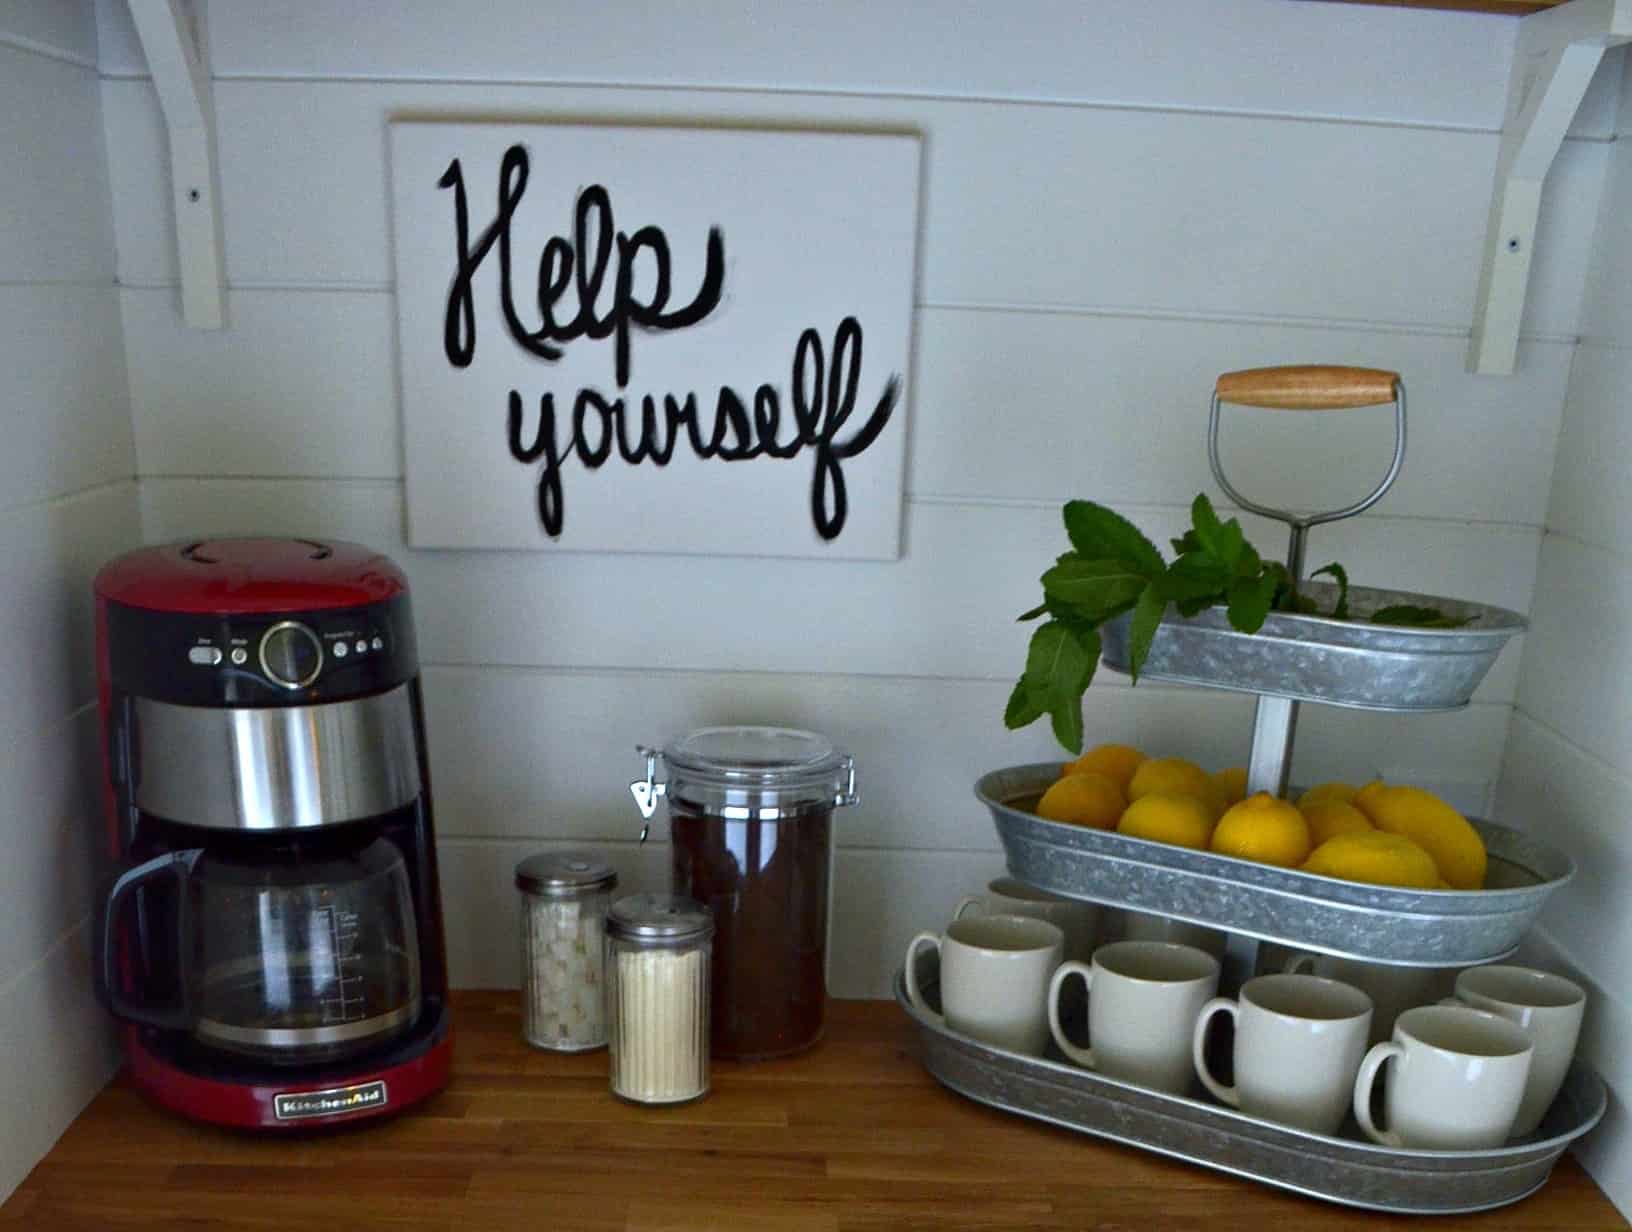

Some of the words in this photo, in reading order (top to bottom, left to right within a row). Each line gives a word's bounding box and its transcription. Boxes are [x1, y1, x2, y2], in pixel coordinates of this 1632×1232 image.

[438, 144, 724, 387] Help
[509, 316, 901, 540] yourself
[283, 1090, 379, 1112] KitchenAid
